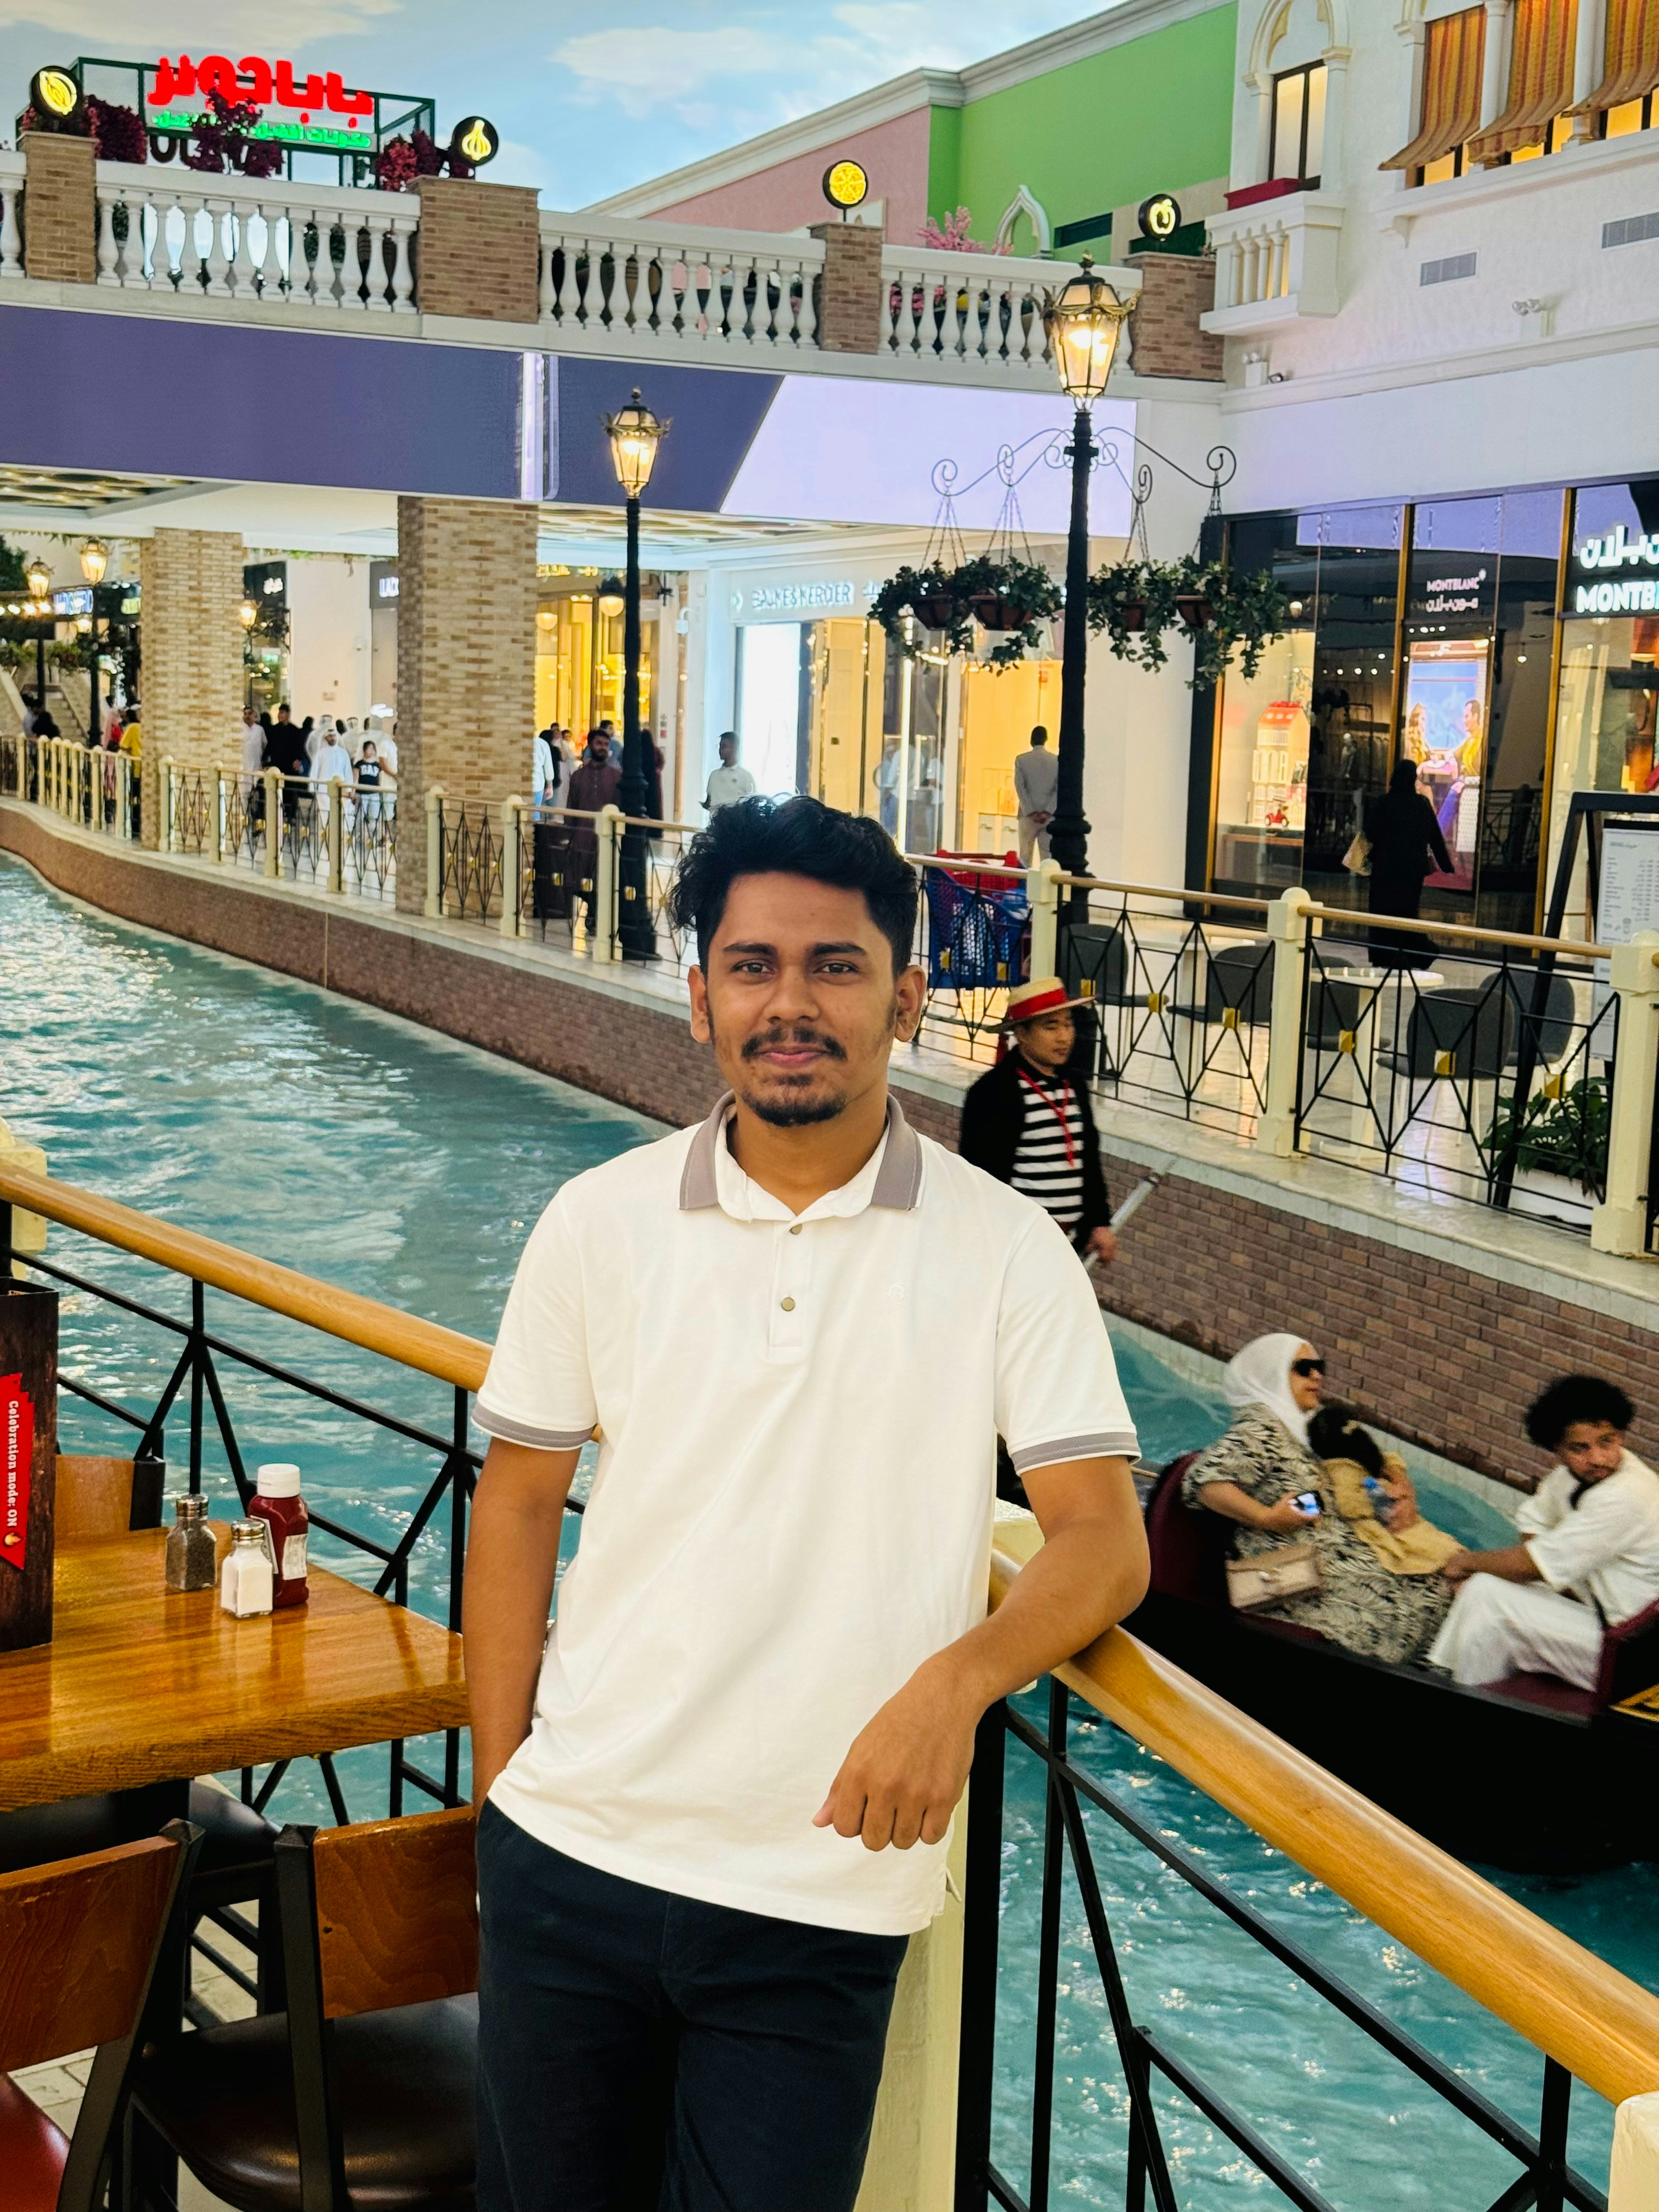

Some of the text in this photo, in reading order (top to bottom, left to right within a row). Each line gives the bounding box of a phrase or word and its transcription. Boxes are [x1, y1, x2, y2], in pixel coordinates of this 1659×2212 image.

[1426, 577, 1480, 592] MONTBLANC
[7, 1400, 20, 1527] Celebration mode: ON
